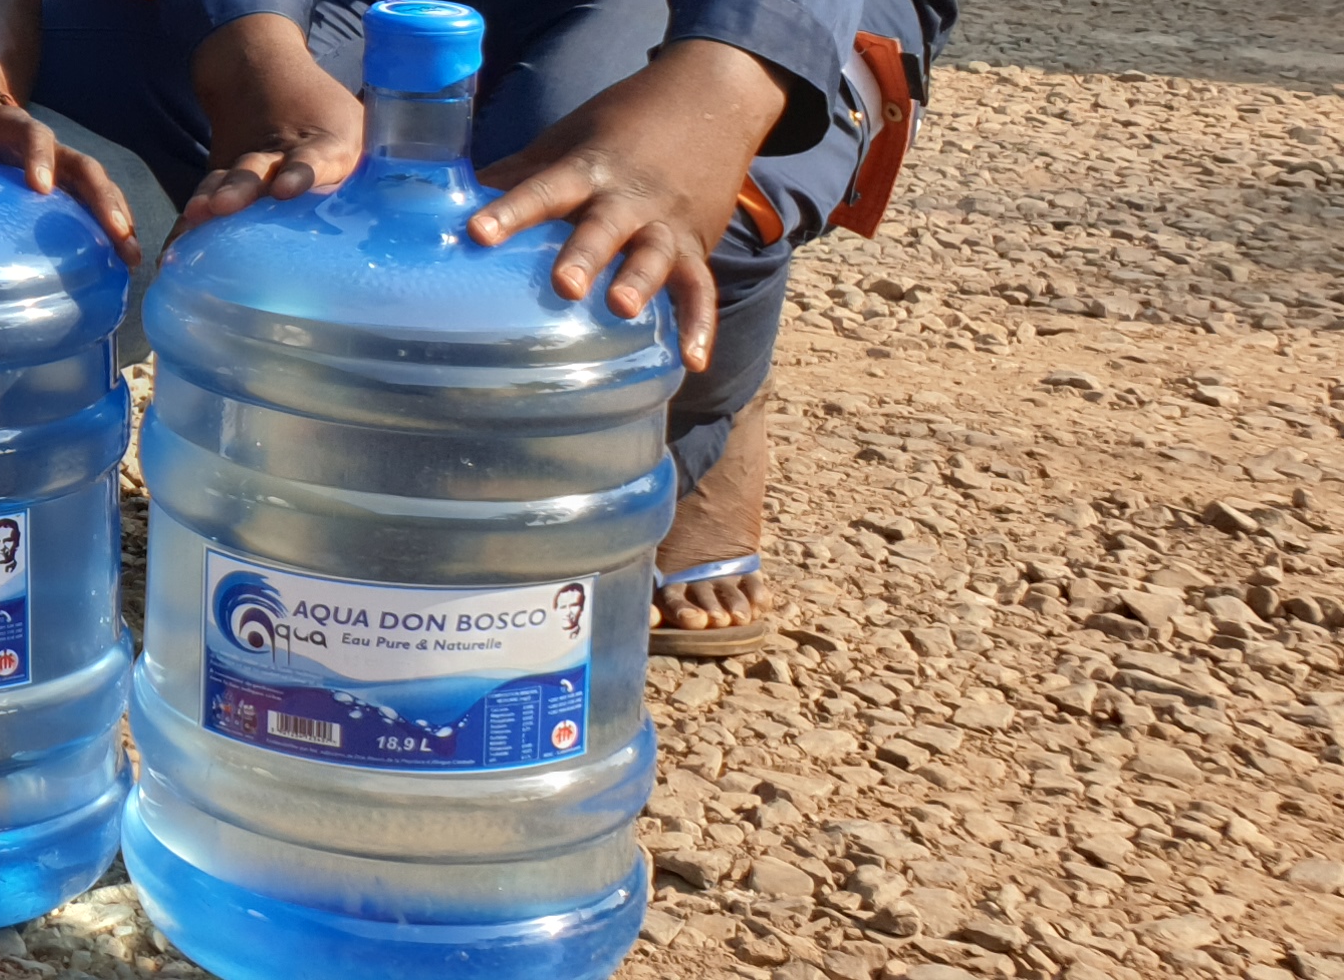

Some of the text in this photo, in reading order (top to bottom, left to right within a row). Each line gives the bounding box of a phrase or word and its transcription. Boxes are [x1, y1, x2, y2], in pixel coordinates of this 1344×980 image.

[292, 600, 547, 632] AQUA DON BOSCO
[341, 632, 502, 652] Eau Pure & Naturelle
[376, 735, 433, 752] 18,9 L
